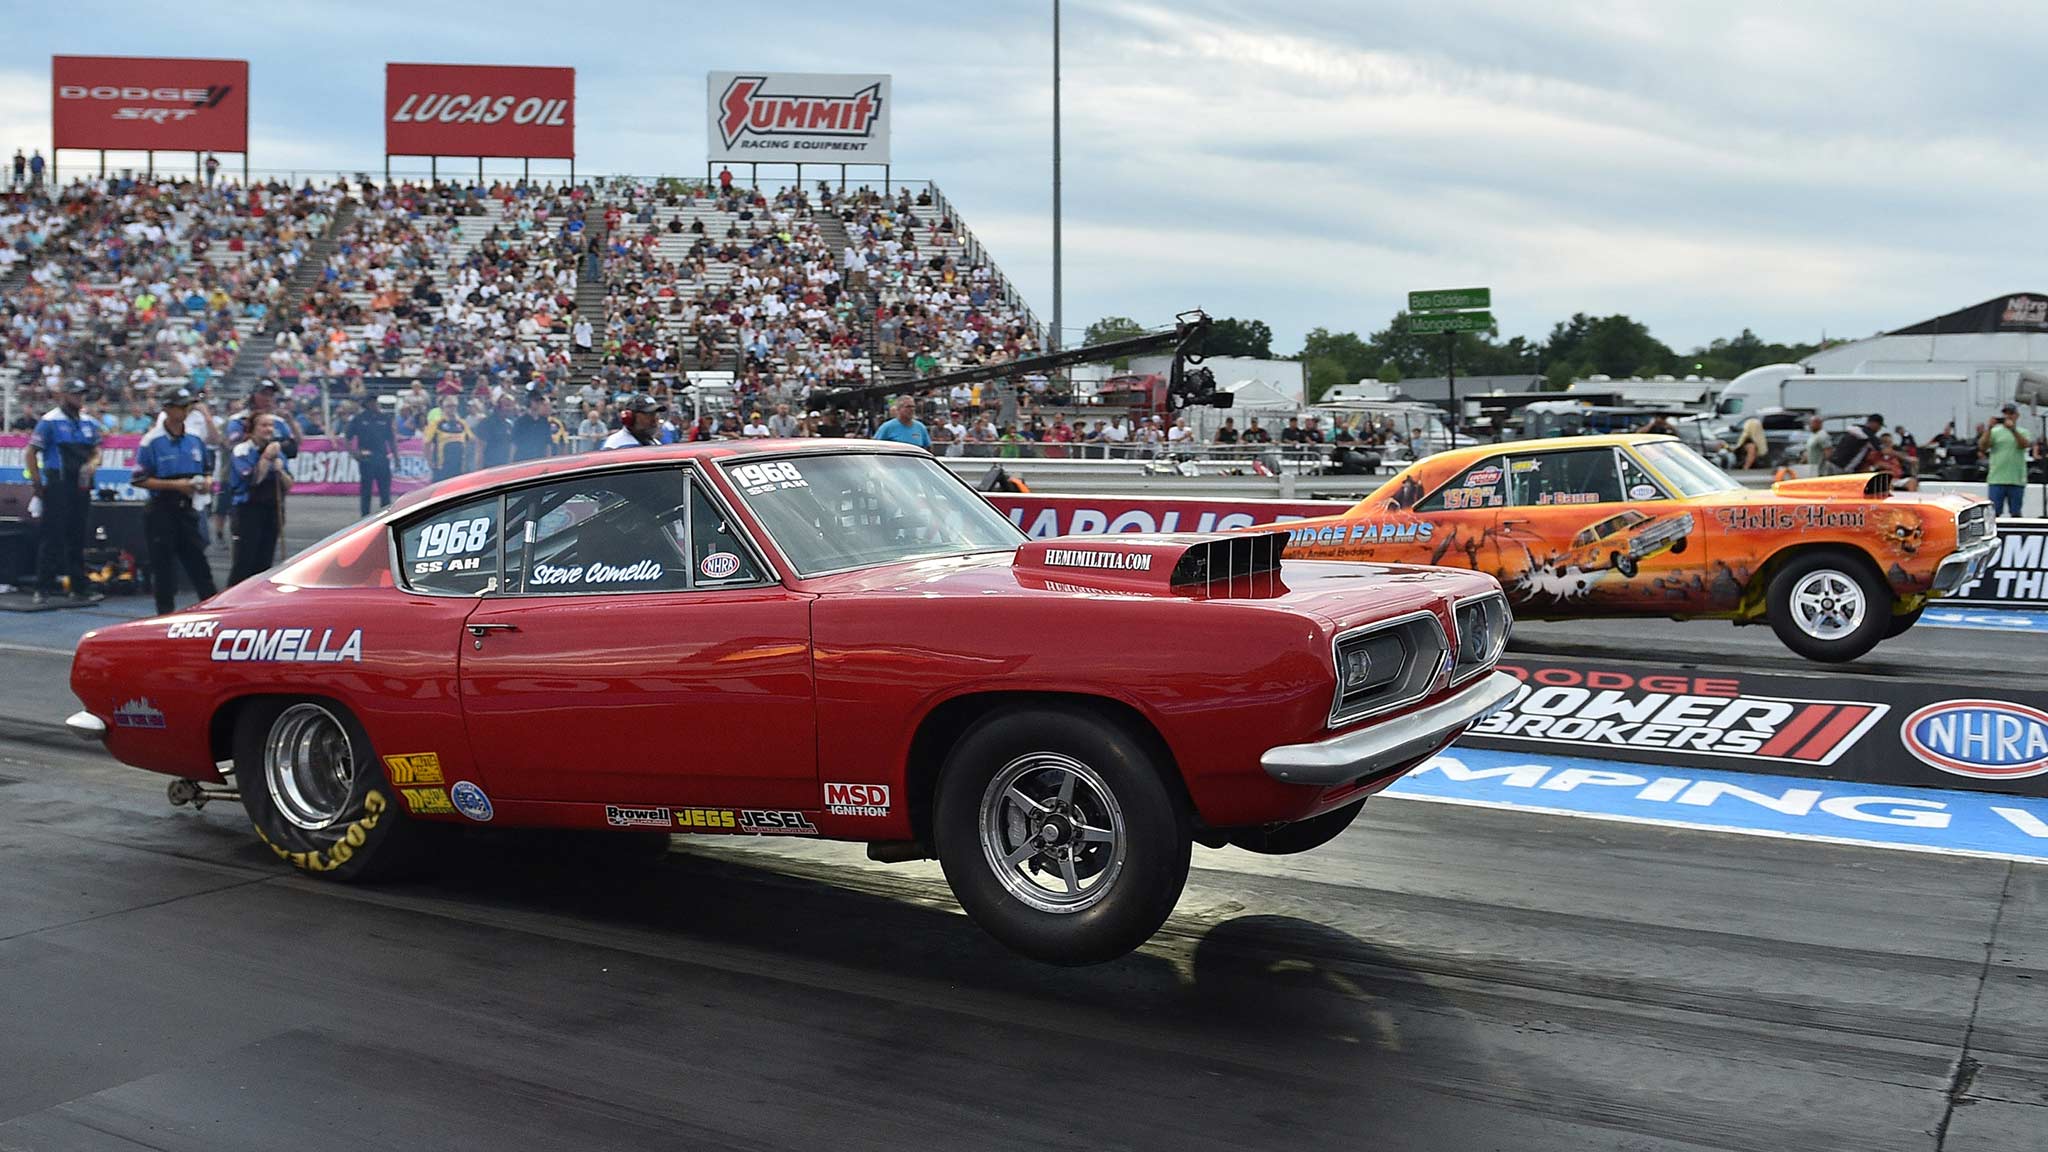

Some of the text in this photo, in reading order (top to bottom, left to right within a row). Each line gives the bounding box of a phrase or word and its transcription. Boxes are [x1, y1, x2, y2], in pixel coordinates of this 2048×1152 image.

[60, 85, 209, 101] DODGE
[112, 107, 197, 124] SRT
[392, 94, 567, 126] LUCAS OIL
[741, 140, 868, 151] RACING EQUIPMENT
[731, 462, 802, 488] 1968
[746, 480, 809, 496] SS AH
[417, 517, 490, 558] 1968
[1349, 521, 1434, 545] FARMS
[415, 558, 480, 574] SS AH
[708, 557, 734, 573] NHRA
[1044, 549, 1152, 571] HEMIMILITIA.COM
[530, 559, 663, 586] Steve Comella
[167, 621, 219, 639] CHUCK
[211, 629, 362, 662] COMELLA
[1474, 712, 1775, 754] BROKERS
[1927, 711, 2048, 762] NHRA
[828, 784, 887, 806] MSD
[607, 806, 669, 820] Browell
[677, 809, 735, 827] JEGS
[740, 810, 814, 829] JESEL
[831, 805, 887, 817] IGNITION
